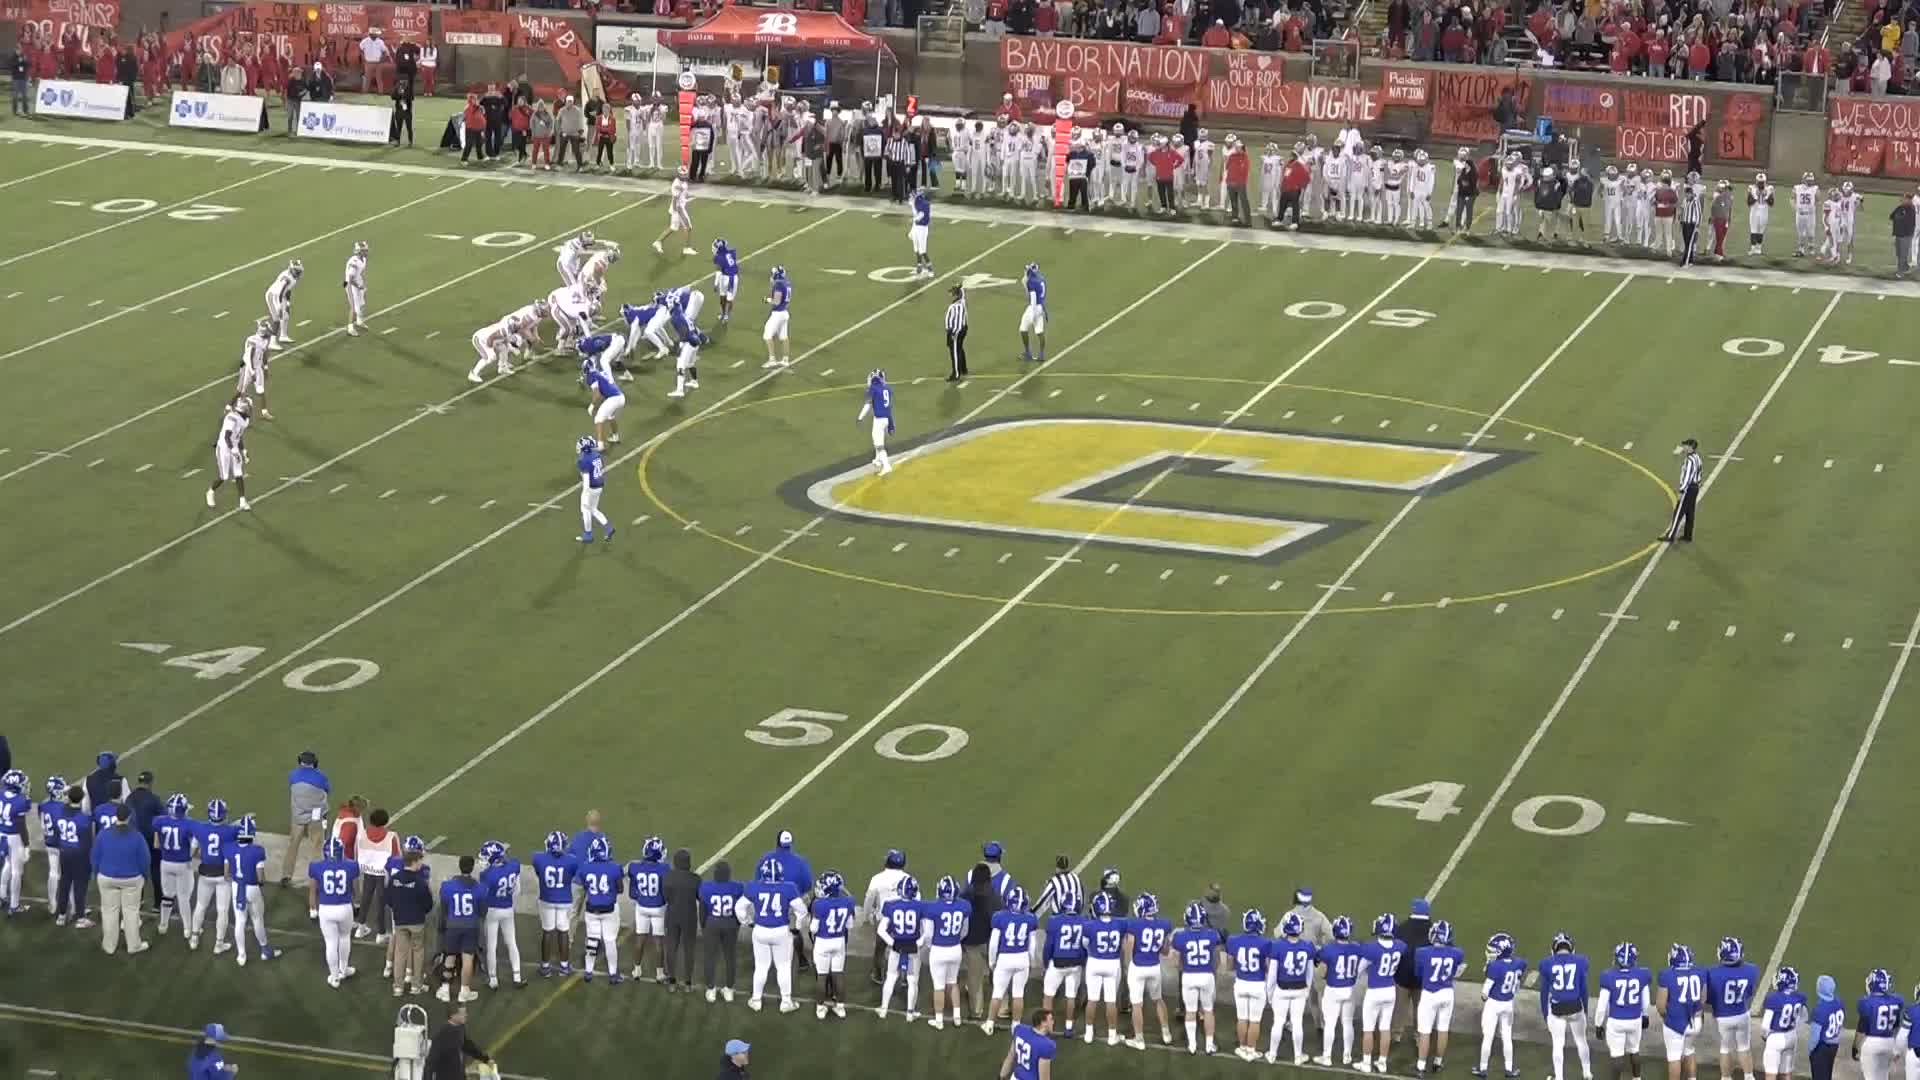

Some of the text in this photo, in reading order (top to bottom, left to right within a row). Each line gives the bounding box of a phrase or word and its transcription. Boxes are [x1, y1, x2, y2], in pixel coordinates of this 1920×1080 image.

[1007, 38, 1203, 83] BAYLOR NATION
[1228, 53, 1249, 69] WE
[1229, 69, 1282, 88] OUR BOYS
[1210, 79, 1231, 110] NO
[1235, 86, 1290, 114] GIRLS
[1836, 102, 1866, 127] WE
[1800, 193, 1811, 205] 35
[882, 389, 890, 407] 9
[163, 646, 381, 692] 40
[744, 708, 970, 762] 50
[1371, 780, 1607, 836] 40
[161, 827, 181, 850] 71
[207, 832, 220, 857] 2
[234, 853, 243, 878] 1
[544, 866, 565, 888] 61
[323, 869, 347, 895] 63
[586, 873, 610, 895] 34
[636, 872, 659, 897] 28
[452, 893, 473, 916] 16
[710, 895, 732, 917] 32
[758, 893, 783, 917] 74
[825, 908, 848, 934] 47
[892, 909, 917, 935] 99
[939, 911, 963, 937] 38
[1005, 922, 1028, 947] 44
[1059, 924, 1082, 950] 27
[1096, 930, 1120, 953] 53
[1141, 928, 1165, 952] 93
[1186, 939, 1210, 965] 25
[1237, 947, 1260, 972] 46
[1283, 951, 1307, 976] 43
[1378, 951, 1401, 977] 82
[1335, 954, 1358, 980] 40
[1430, 957, 1454, 982] 73
[1551, 962, 1577, 990] 37
[1615, 979, 1640, 1006] 72
[1677, 975, 1700, 1002] 70
[1724, 979, 1748, 1005] 67
[1876, 1004, 1899, 1030] 65
[1015, 1037, 1031, 1071] 52
